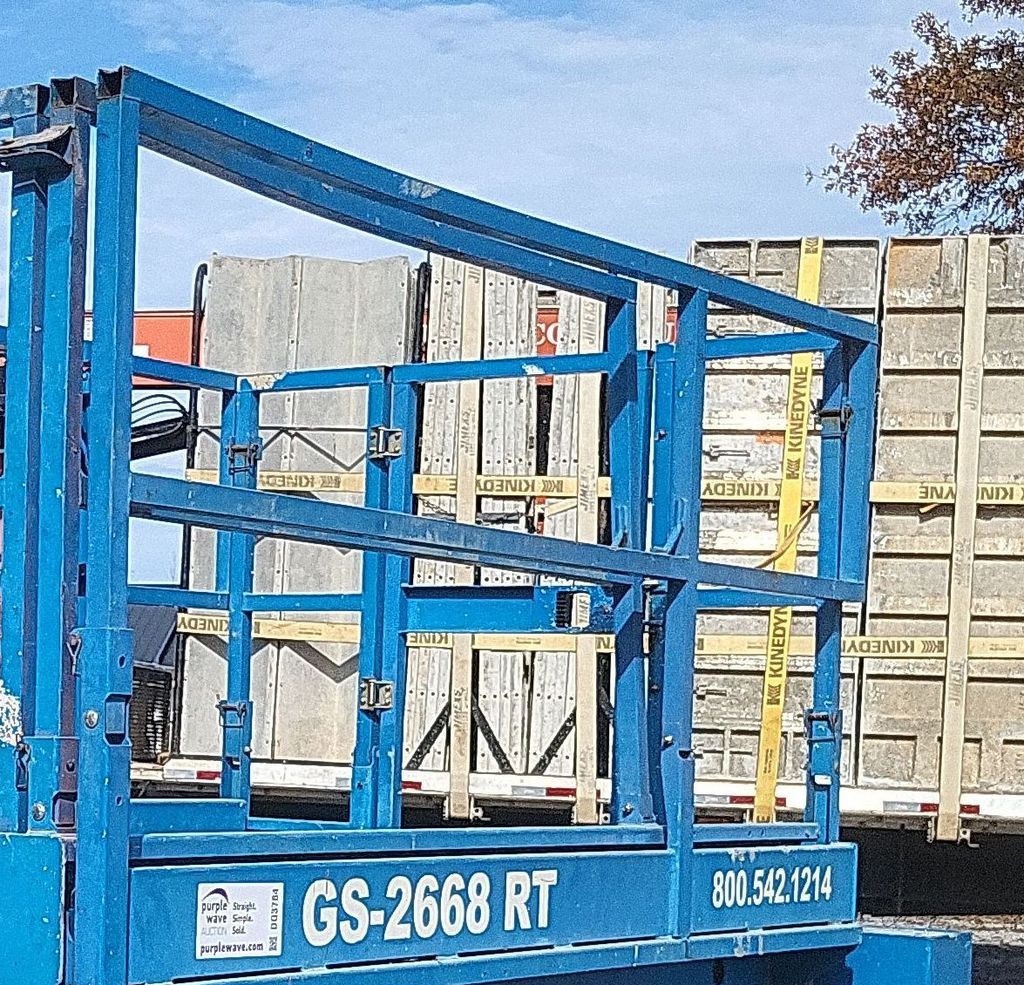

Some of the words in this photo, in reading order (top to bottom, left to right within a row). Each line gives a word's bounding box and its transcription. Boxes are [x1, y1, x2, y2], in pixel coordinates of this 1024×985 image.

[788, 366, 809, 452] KINEDYNE
[702, 482, 769, 496] KINEDY
[769, 606, 789, 678] KINEDYN
[843, 640, 915, 653] KINEDY
[712, 865, 832, 908] 800.542.1214
[201, 899, 228, 914] purple
[302, 872, 490, 947] GS-2668
[504, 869, 558, 931] RT
[206, 914, 227, 923] wave
[200, 941, 264, 956] purplewave.com
